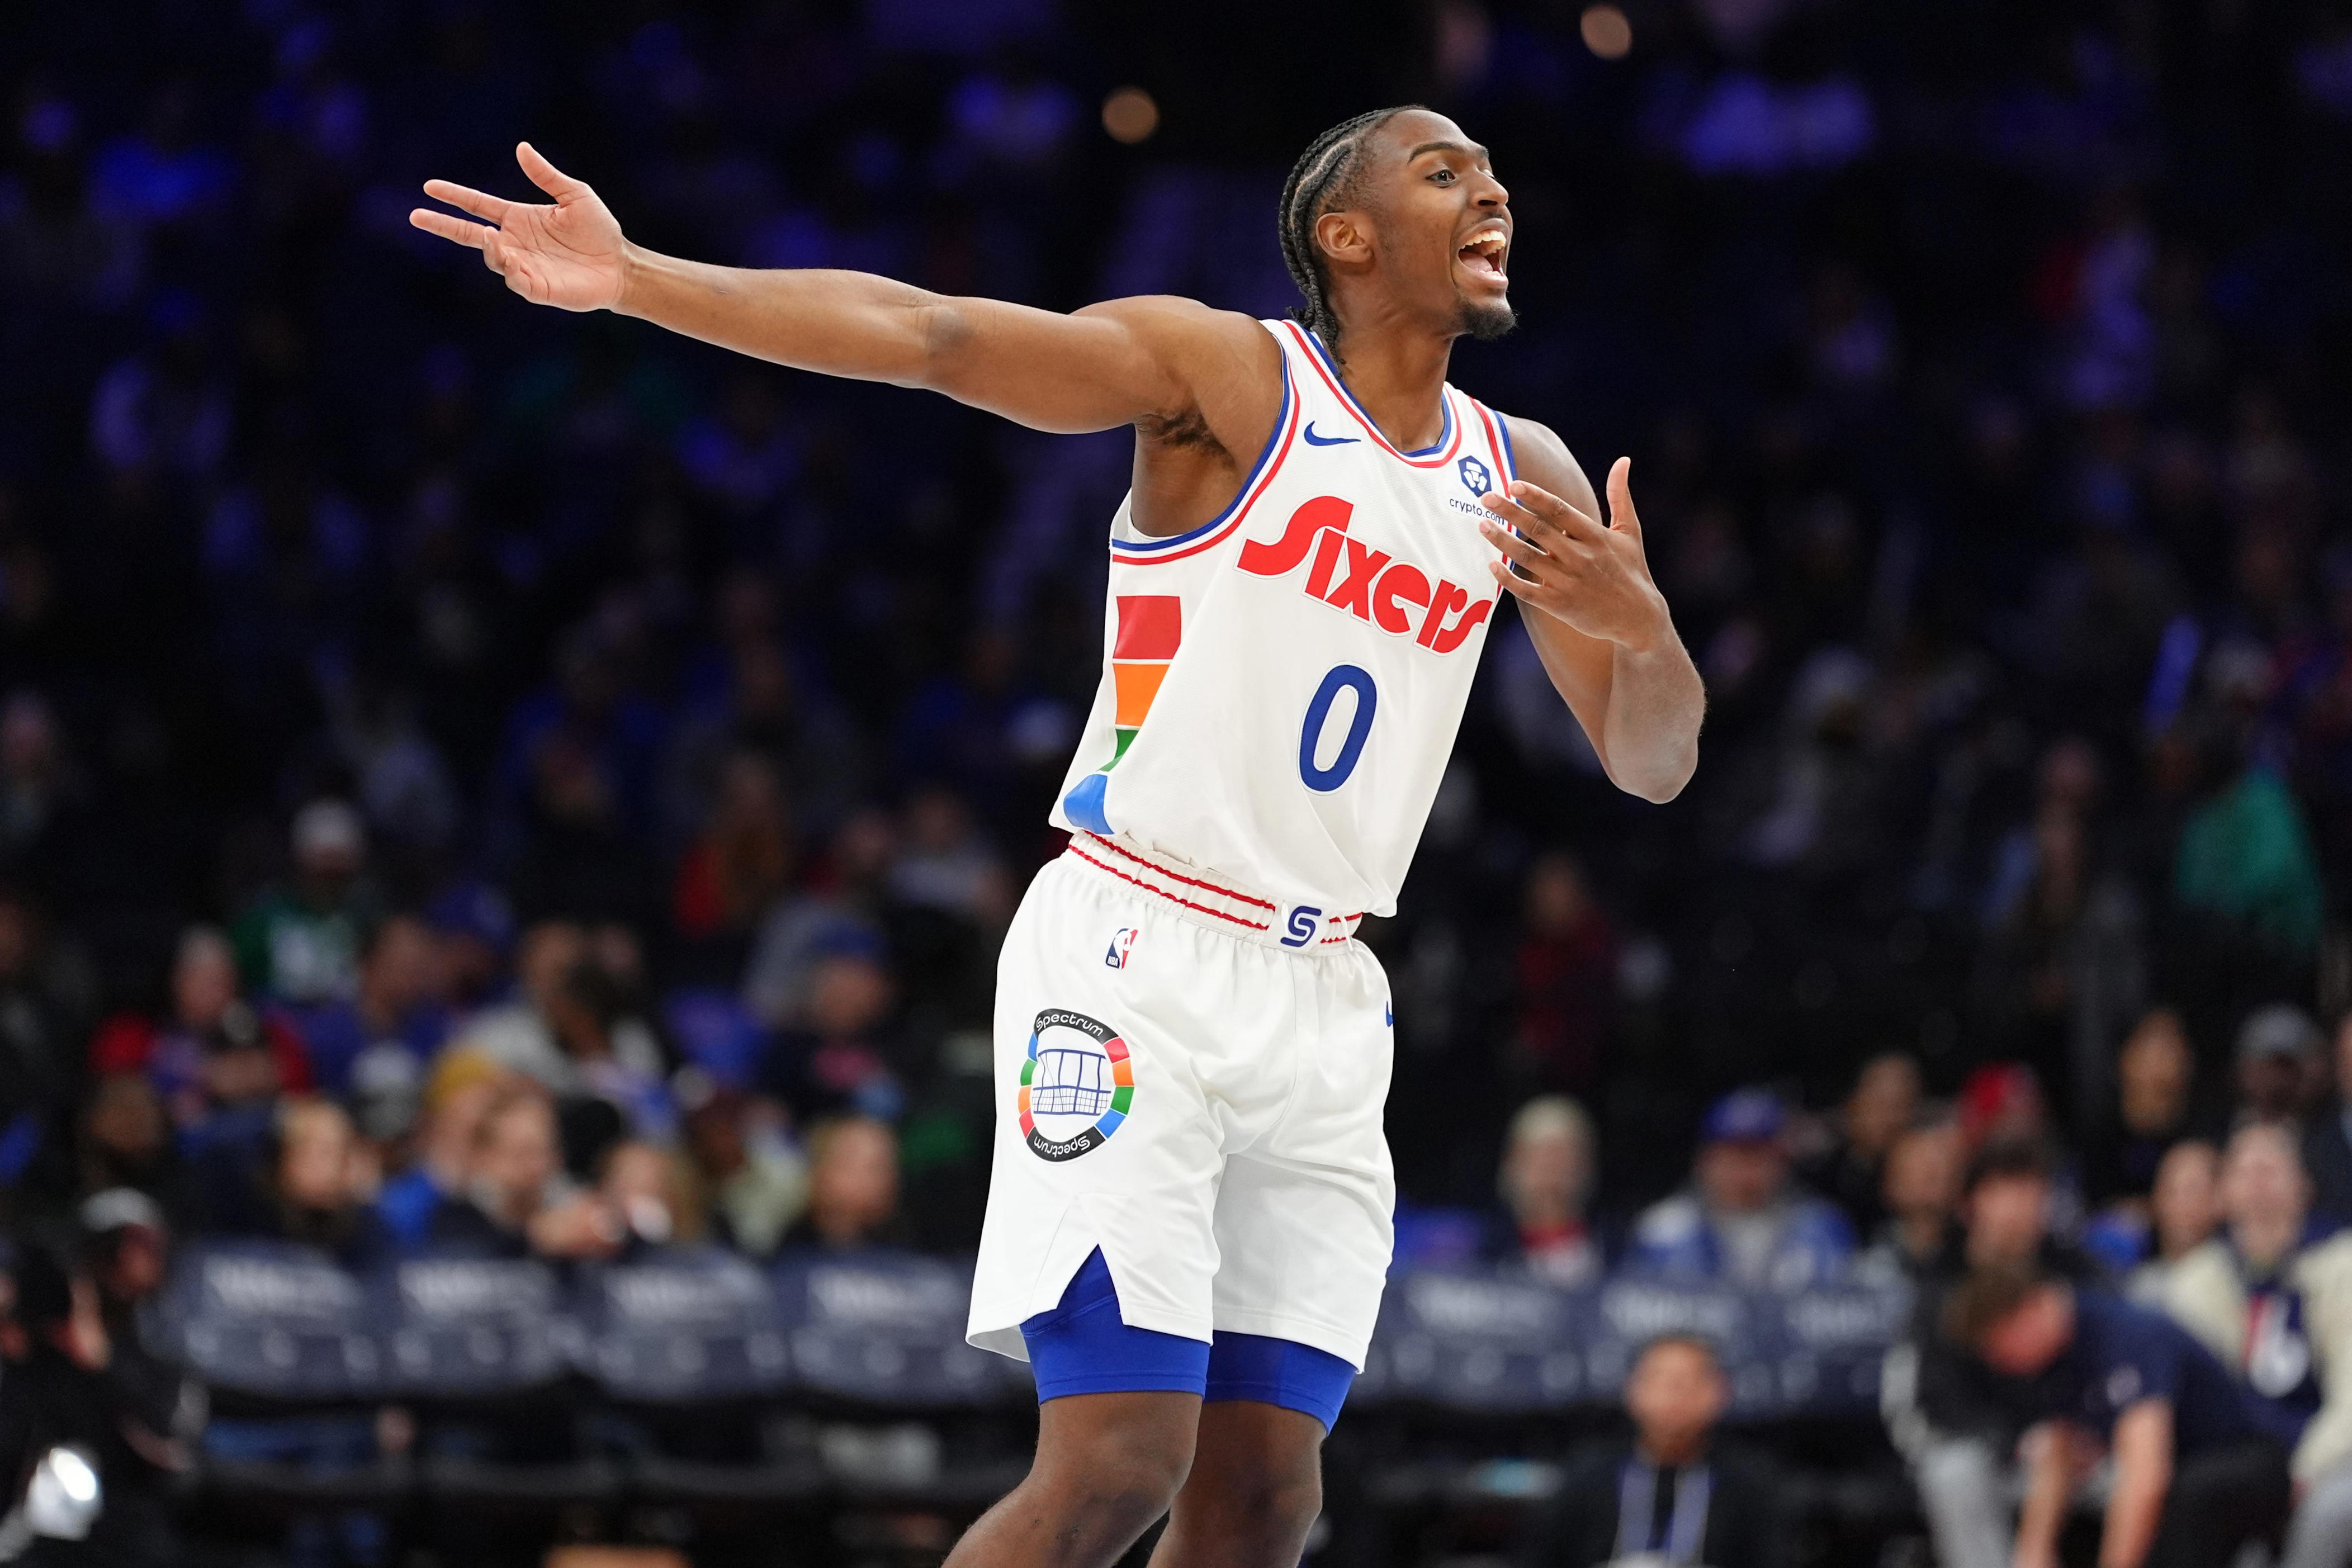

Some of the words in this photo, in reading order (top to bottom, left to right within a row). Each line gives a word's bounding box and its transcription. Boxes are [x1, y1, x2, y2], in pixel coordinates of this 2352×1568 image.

[1450, 498, 1504, 525] crypto.com
[1236, 495, 1493, 654] Sixers
[1299, 664, 1377, 792] 0
[1107, 955, 1119, 967] NBA
[1035, 1013, 1104, 1037] Spectrum
[1034, 1135, 1091, 1158] Spectrum
